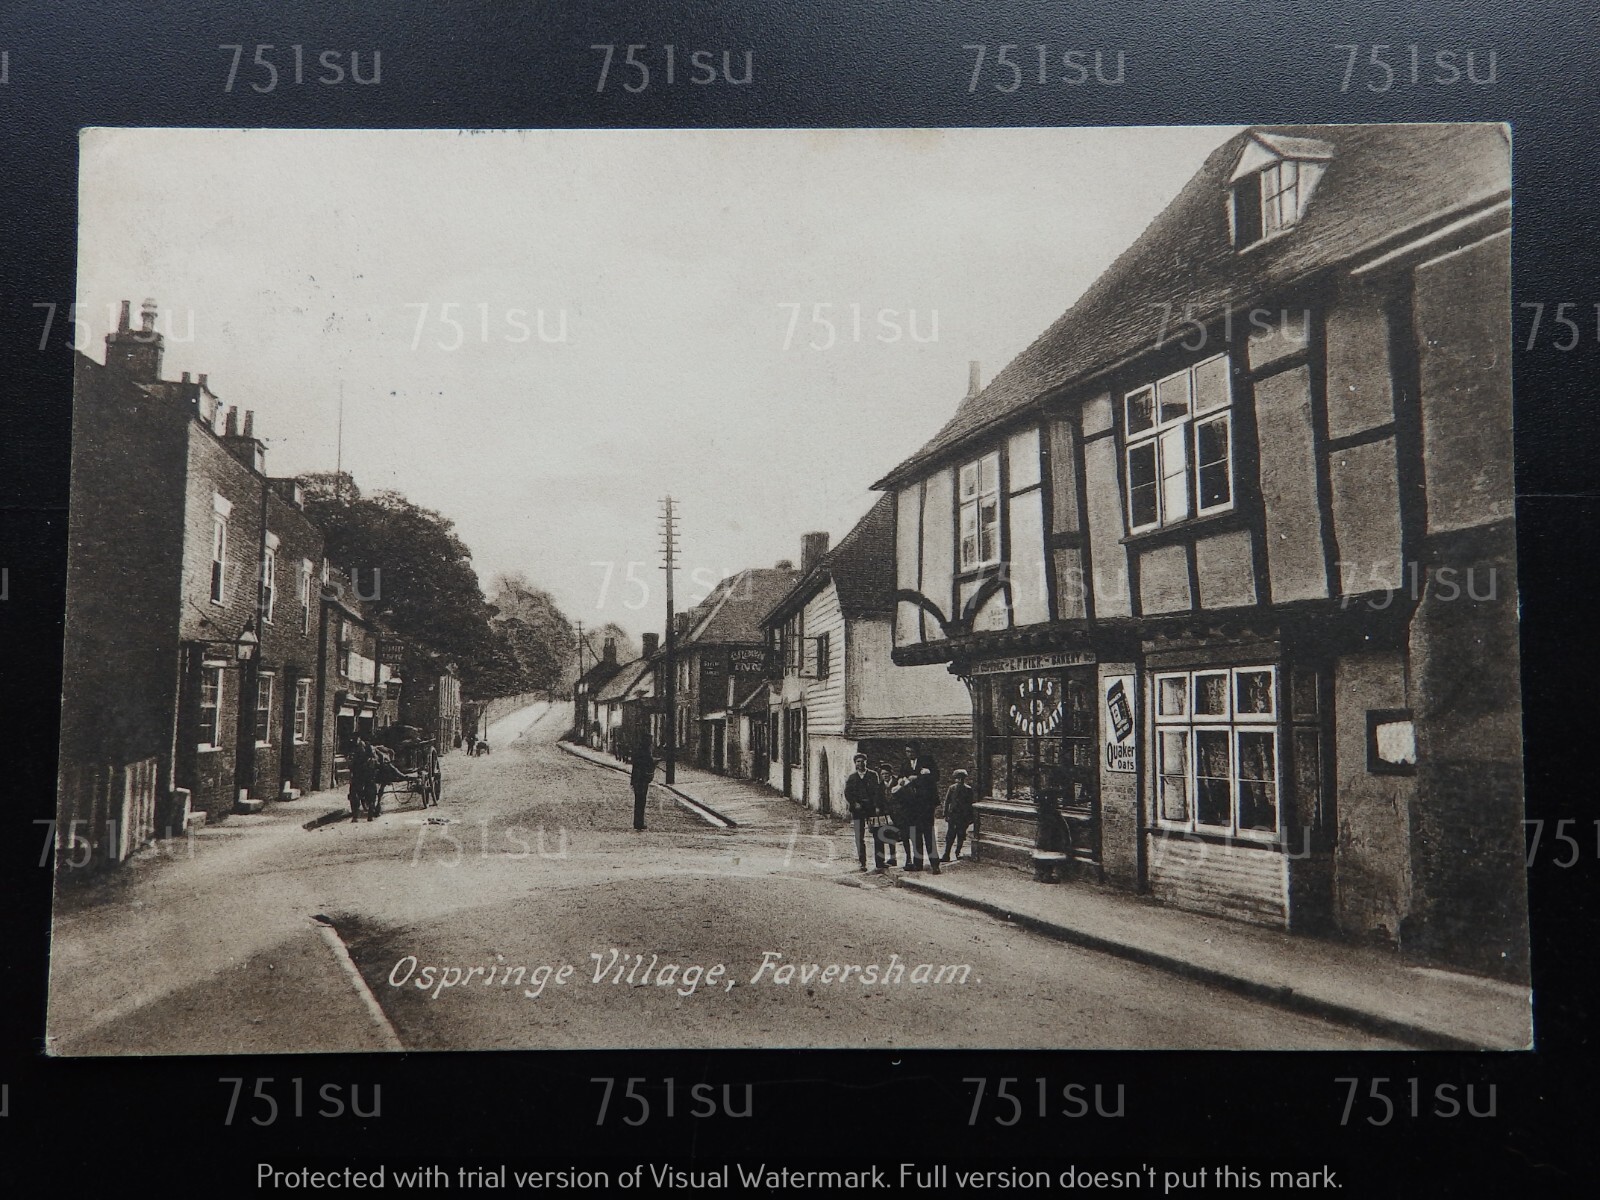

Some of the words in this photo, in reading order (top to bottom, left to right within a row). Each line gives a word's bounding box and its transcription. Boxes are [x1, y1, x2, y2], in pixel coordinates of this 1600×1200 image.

[1107, 741, 1135, 768] Quaker
[1118, 759, 1135, 770] Oats
[388, 954, 575, 1000] Ospringe
[590, 948, 736, 996] Village,
[750, 951, 982, 986] Faversham.
